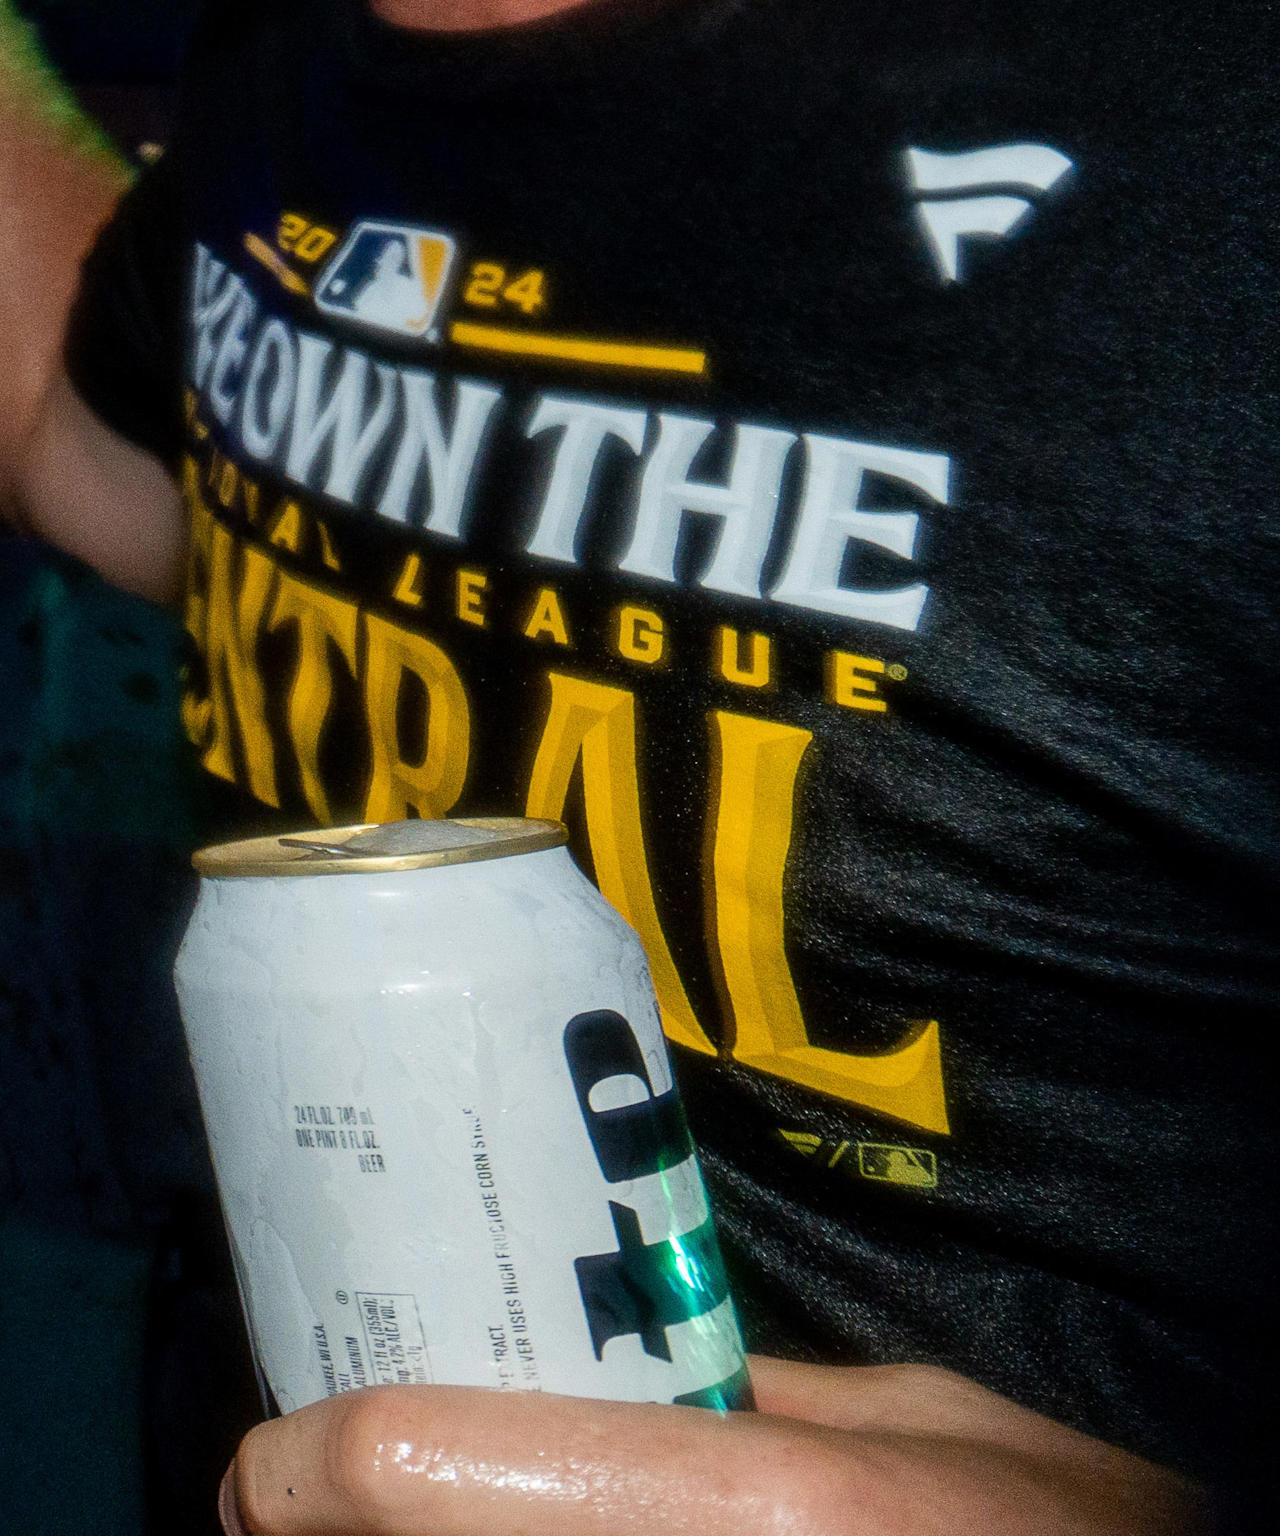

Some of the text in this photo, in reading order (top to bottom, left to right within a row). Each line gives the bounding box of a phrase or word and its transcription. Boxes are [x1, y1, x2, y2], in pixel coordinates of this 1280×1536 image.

[278, 211, 545, 314] 20 24
[241, 317, 504, 541] OWN
[525, 392, 949, 632] THE
[397, 552, 888, 713] LEAGUE
[295, 1129, 315, 1148] ONE
[315, 1129, 338, 1149] PINT
[357, 1154, 386, 1173] BEER
[474, 1153, 496, 1189] CORN
[498, 1263, 519, 1295] HIGH
[506, 1298, 527, 1334] USES
